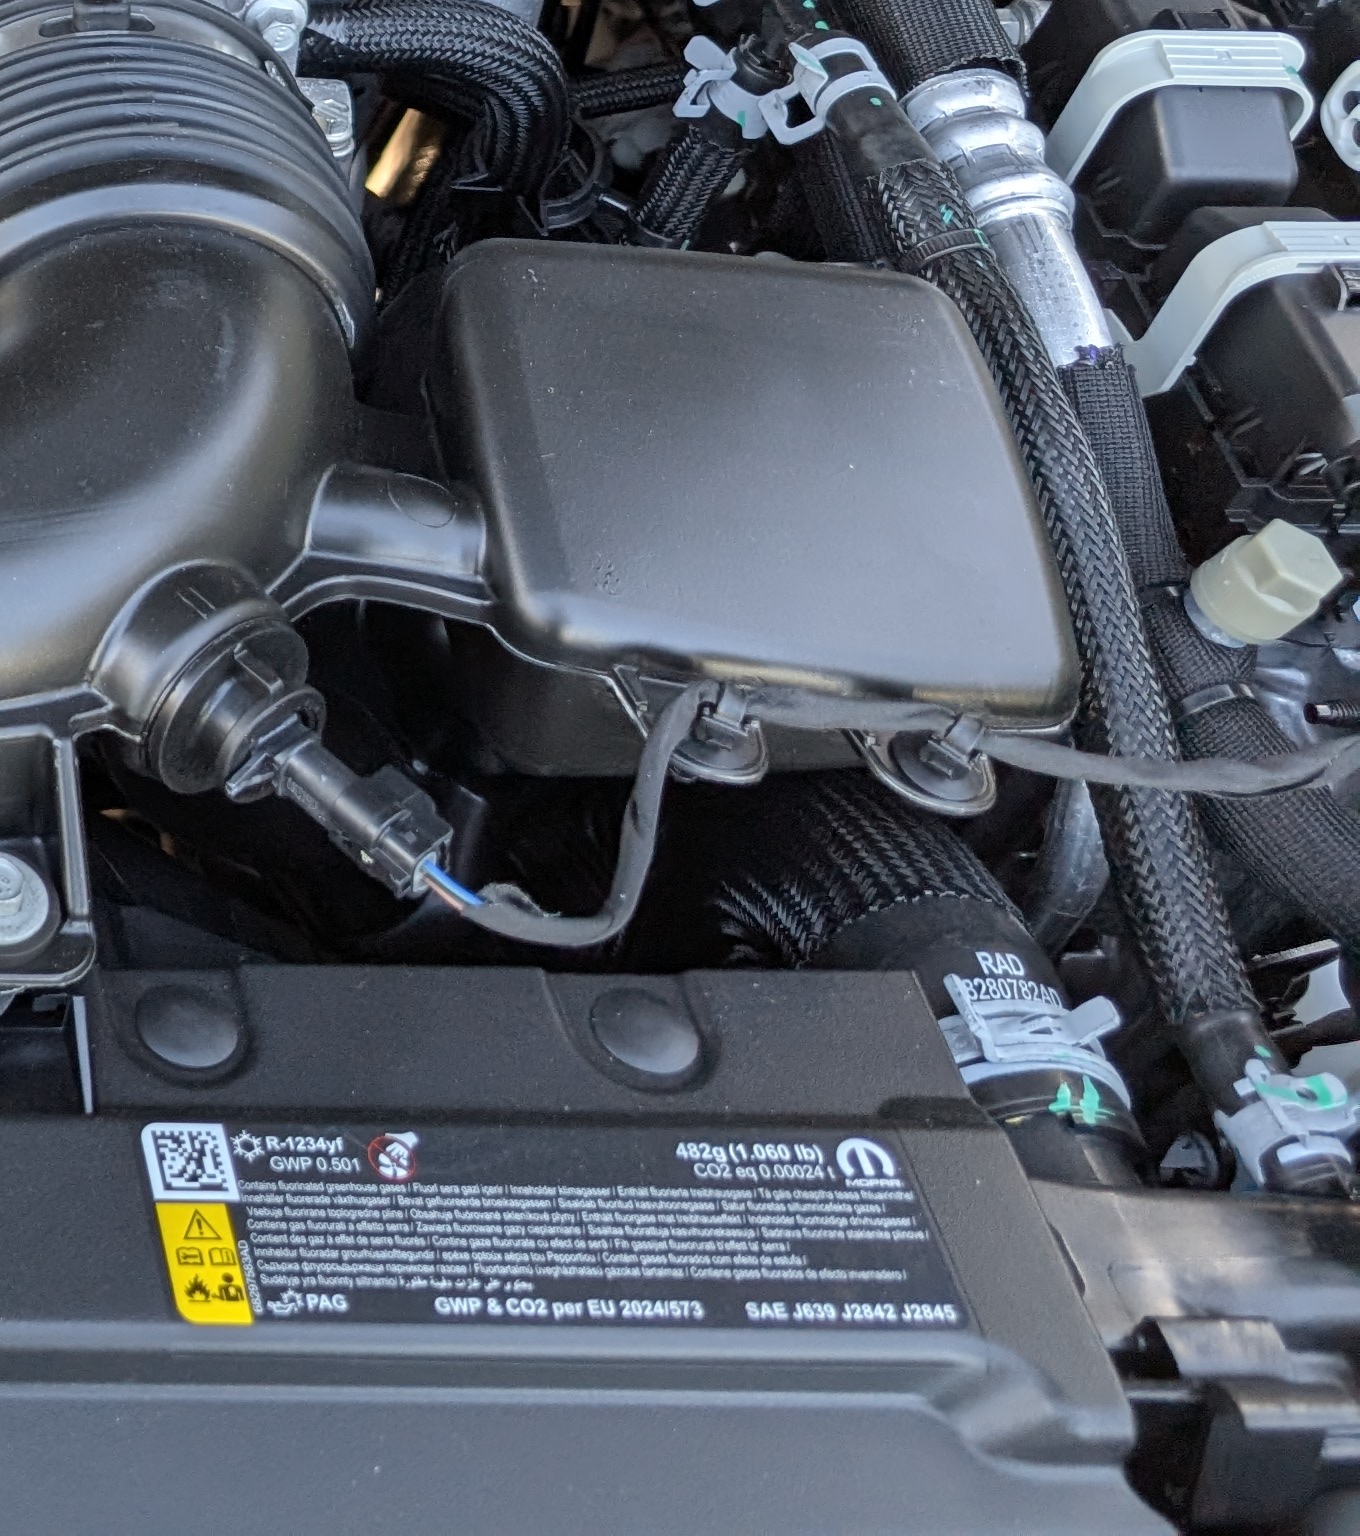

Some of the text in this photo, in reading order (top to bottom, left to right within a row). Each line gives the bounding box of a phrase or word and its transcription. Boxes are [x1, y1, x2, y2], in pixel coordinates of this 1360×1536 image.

[974, 951, 1026, 977] RAD
[265, 1135, 344, 1154] R-1234yf
[675, 1142, 824, 1164] 482g (1.060 lb)
[269, 1156, 361, 1172] GWP 0.501
[693, 1164, 730, 1179] CO2
[735, 1167, 759, 1183] eq
[759, 1164, 825, 1180] 0.00024
[306, 1293, 349, 1312] PAG
[434, 1296, 704, 1321] GWP & CO2 per EU 2024/573
[745, 1303, 957, 1322] SAE J639 J2842 J2845
